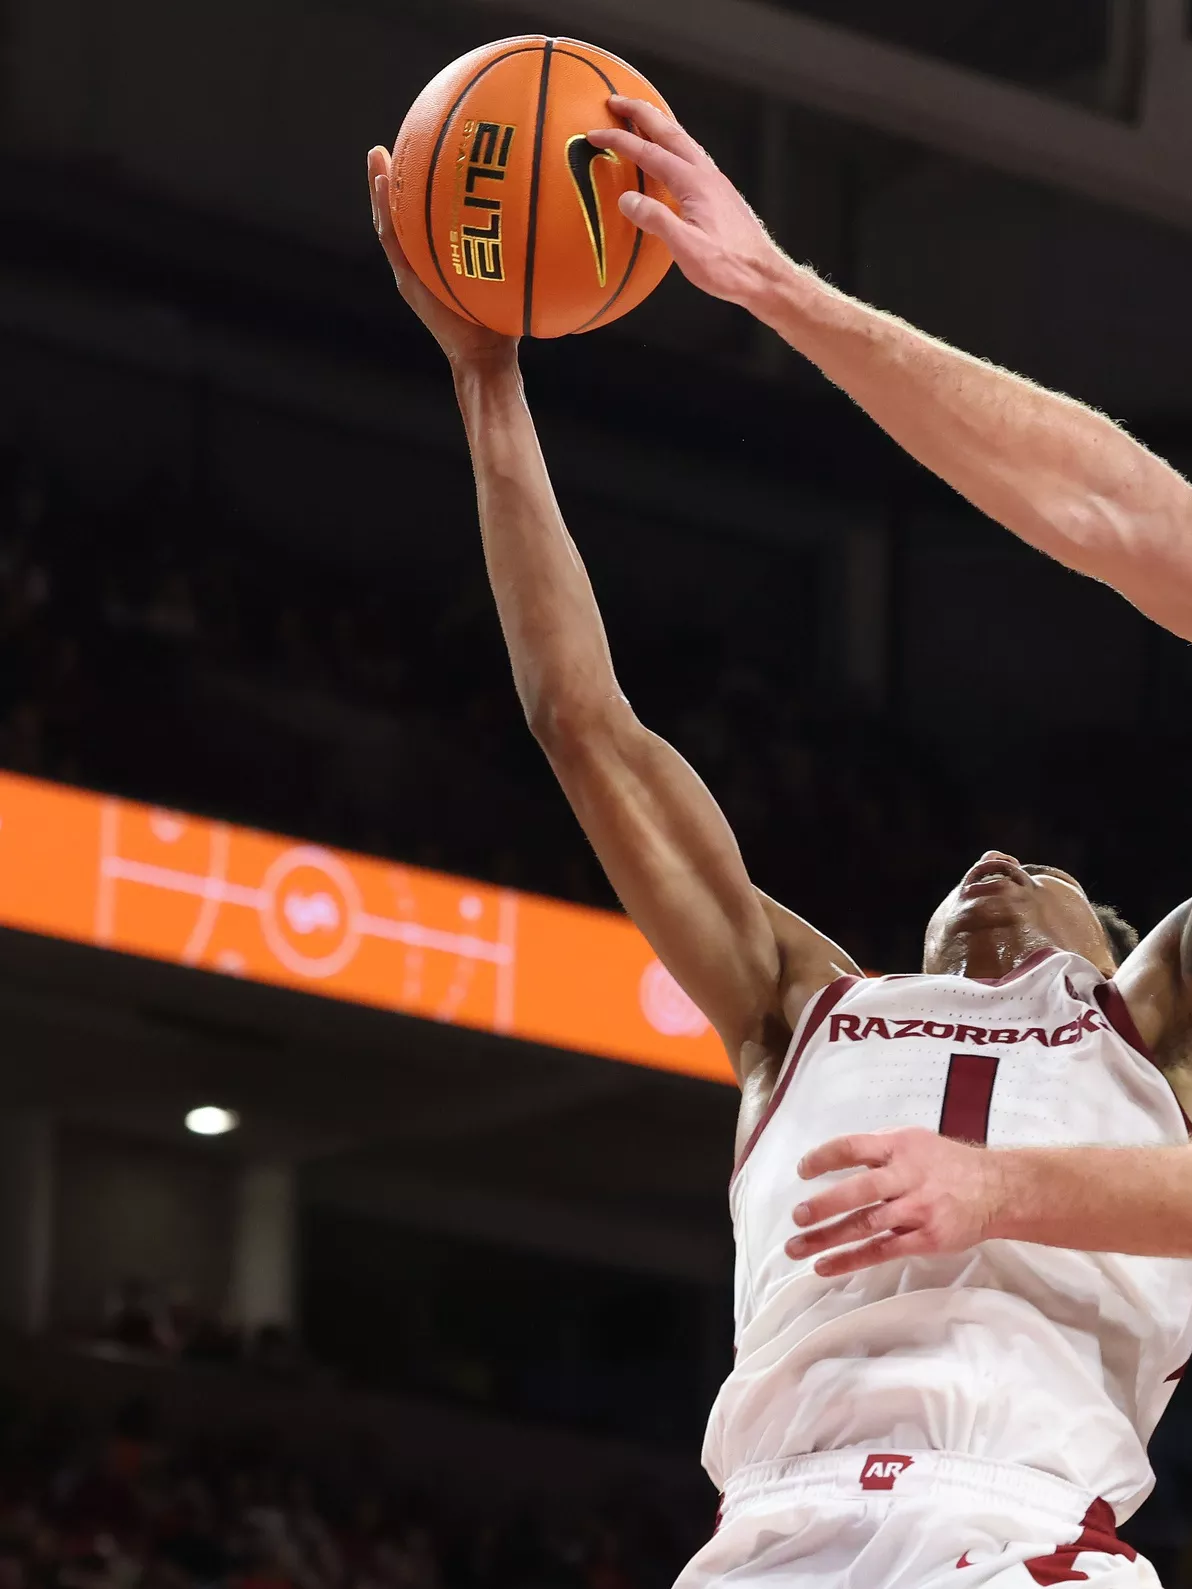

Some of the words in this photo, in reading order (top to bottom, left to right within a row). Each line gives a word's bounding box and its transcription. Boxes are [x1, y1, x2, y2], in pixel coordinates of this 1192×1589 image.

[461, 121, 517, 282] ELITE
[829, 1009, 1112, 1048] RAZORBACK
[939, 1053, 1000, 1148] 1
[864, 1461, 904, 1478] AR
